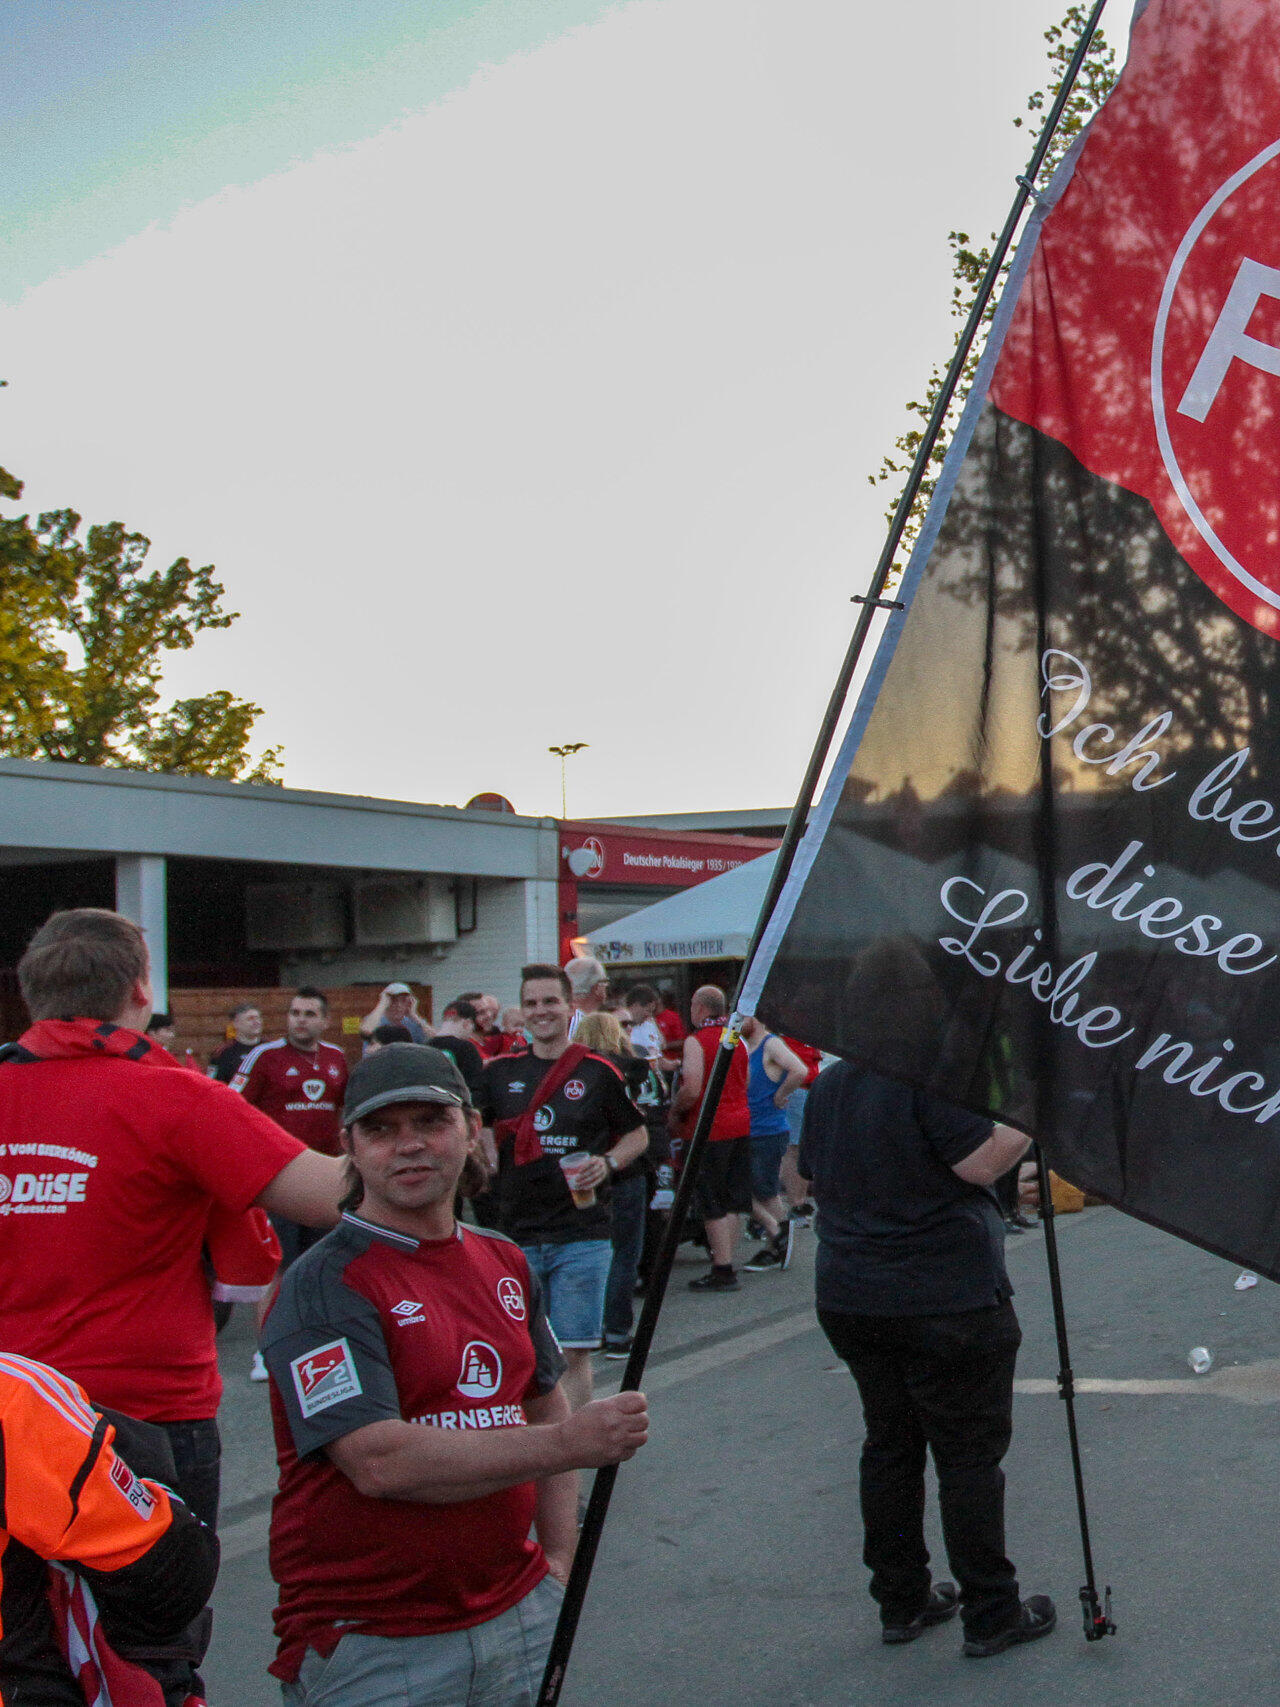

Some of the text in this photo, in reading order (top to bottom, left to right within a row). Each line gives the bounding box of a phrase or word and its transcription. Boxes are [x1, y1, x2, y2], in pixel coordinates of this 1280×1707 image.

[1036, 648, 1176, 792] Ich
[623, 852, 661, 867] Deutscher
[663, 856, 703, 872] Pokalsieger
[1066, 840, 1277, 975] diese
[938, 876, 1135, 1048] Liebe
[397, 1315, 426, 1327] umbro
[333, 1365, 349, 1384] 2
[307, 1385, 355, 1411] BUNDESLIGA
